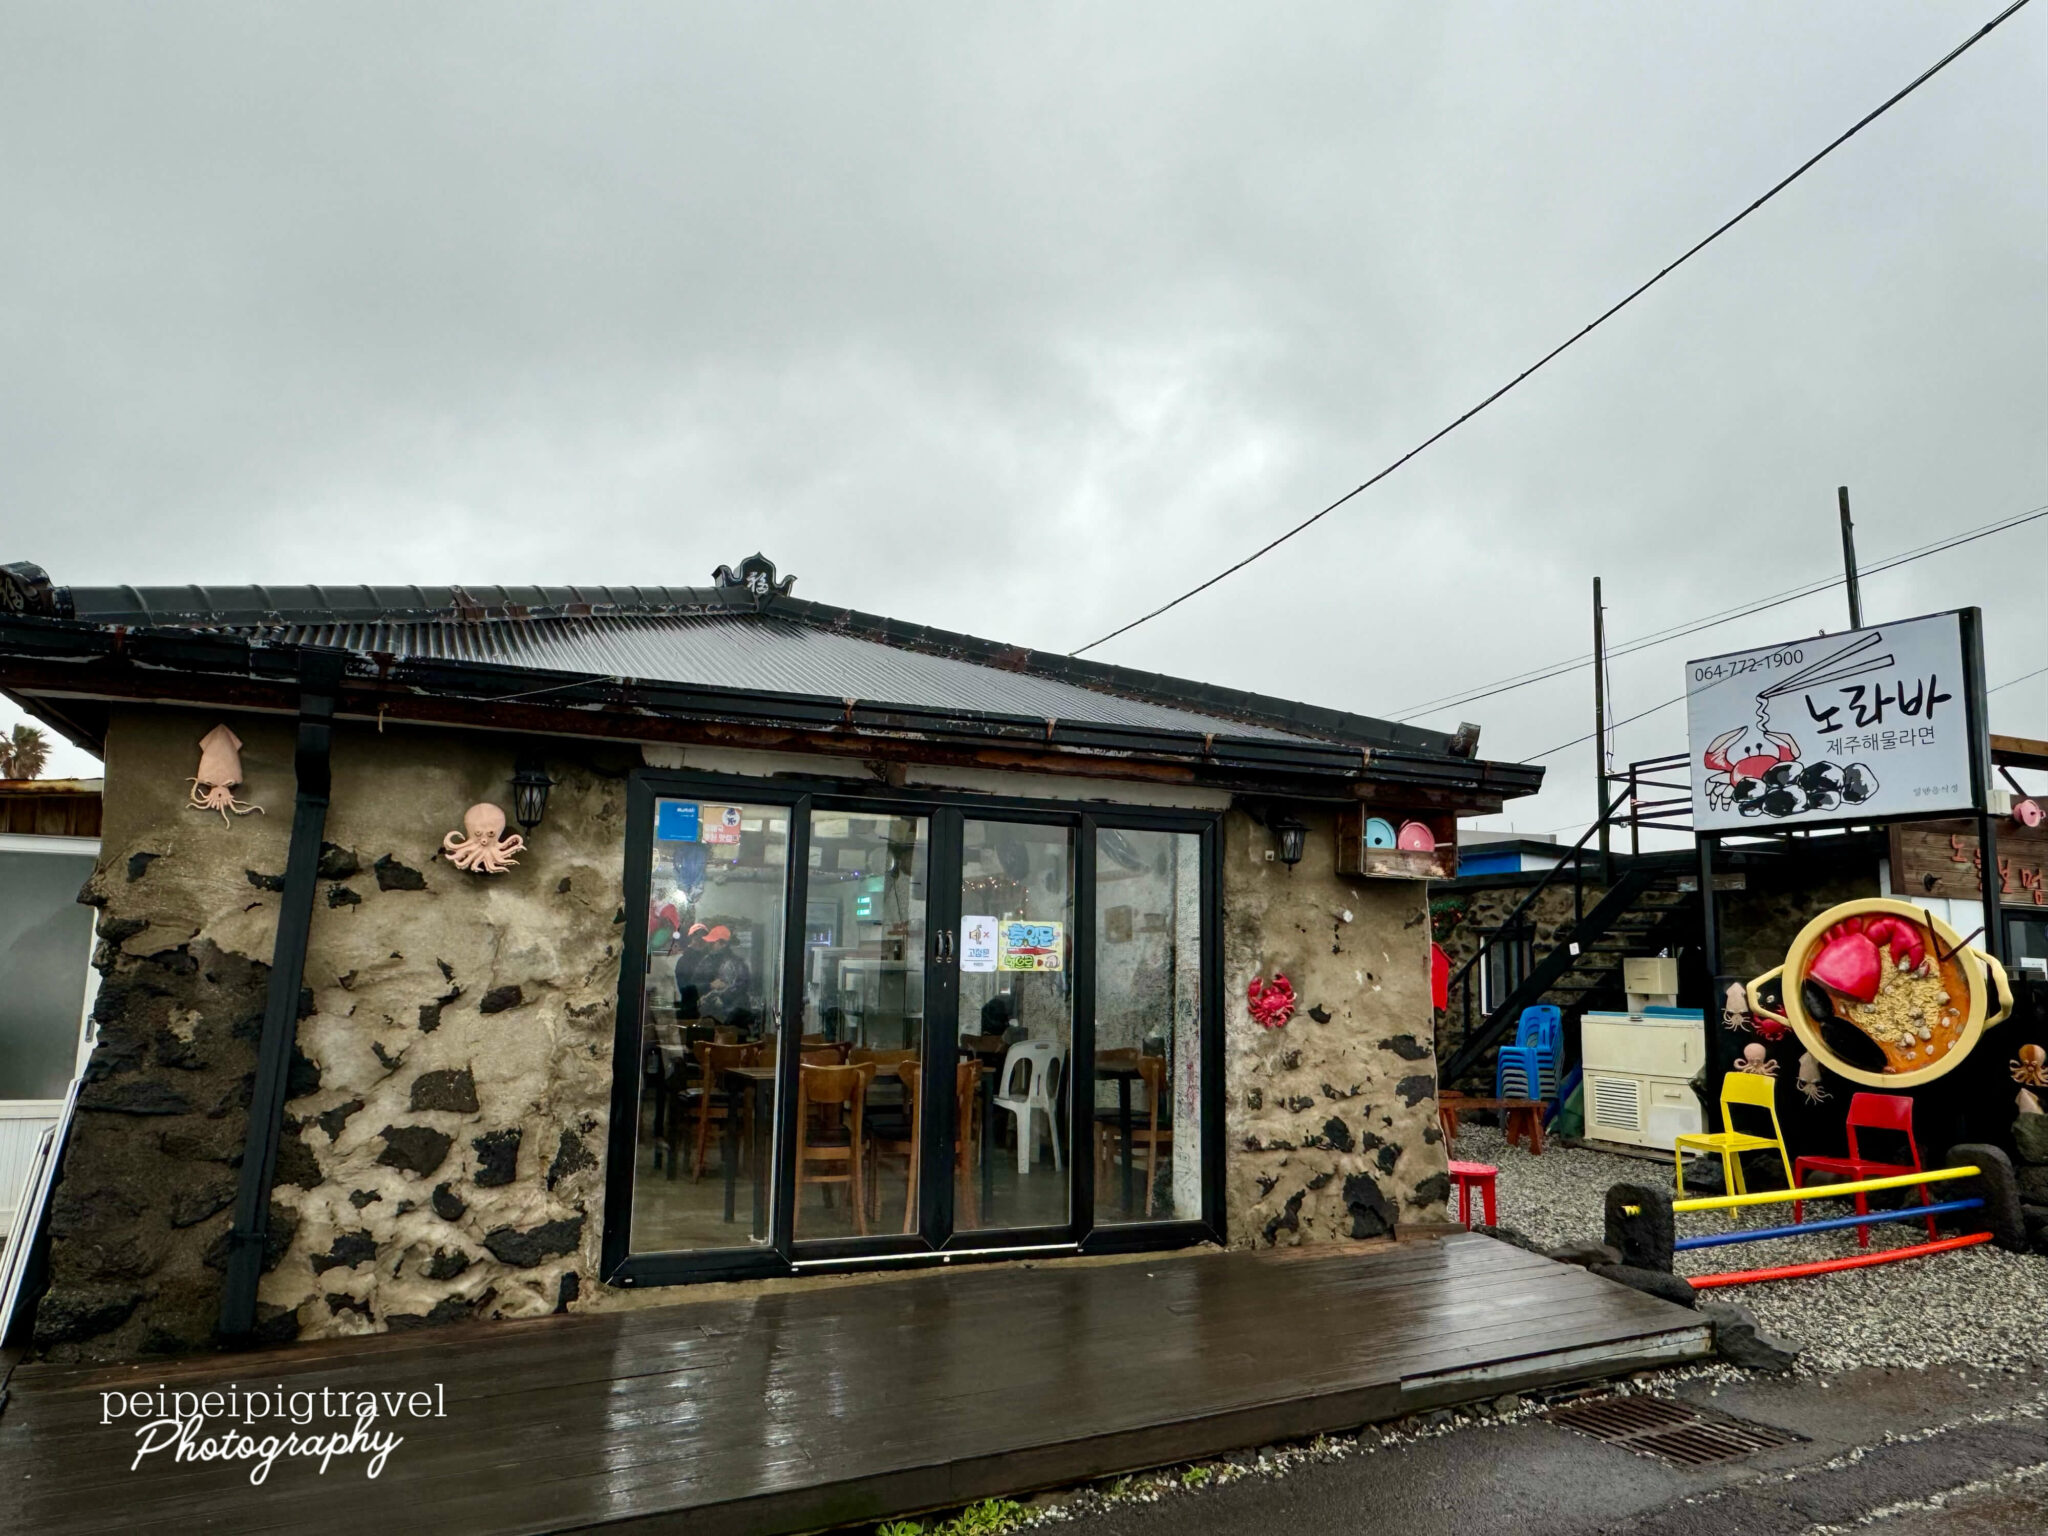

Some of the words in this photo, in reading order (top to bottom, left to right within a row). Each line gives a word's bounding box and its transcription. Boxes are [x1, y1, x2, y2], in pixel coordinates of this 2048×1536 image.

[1695, 649, 1804, 682] 064-772-1900
[1804, 673, 1953, 735] 노라바
[1826, 725, 1936, 757] 제주해물라면
